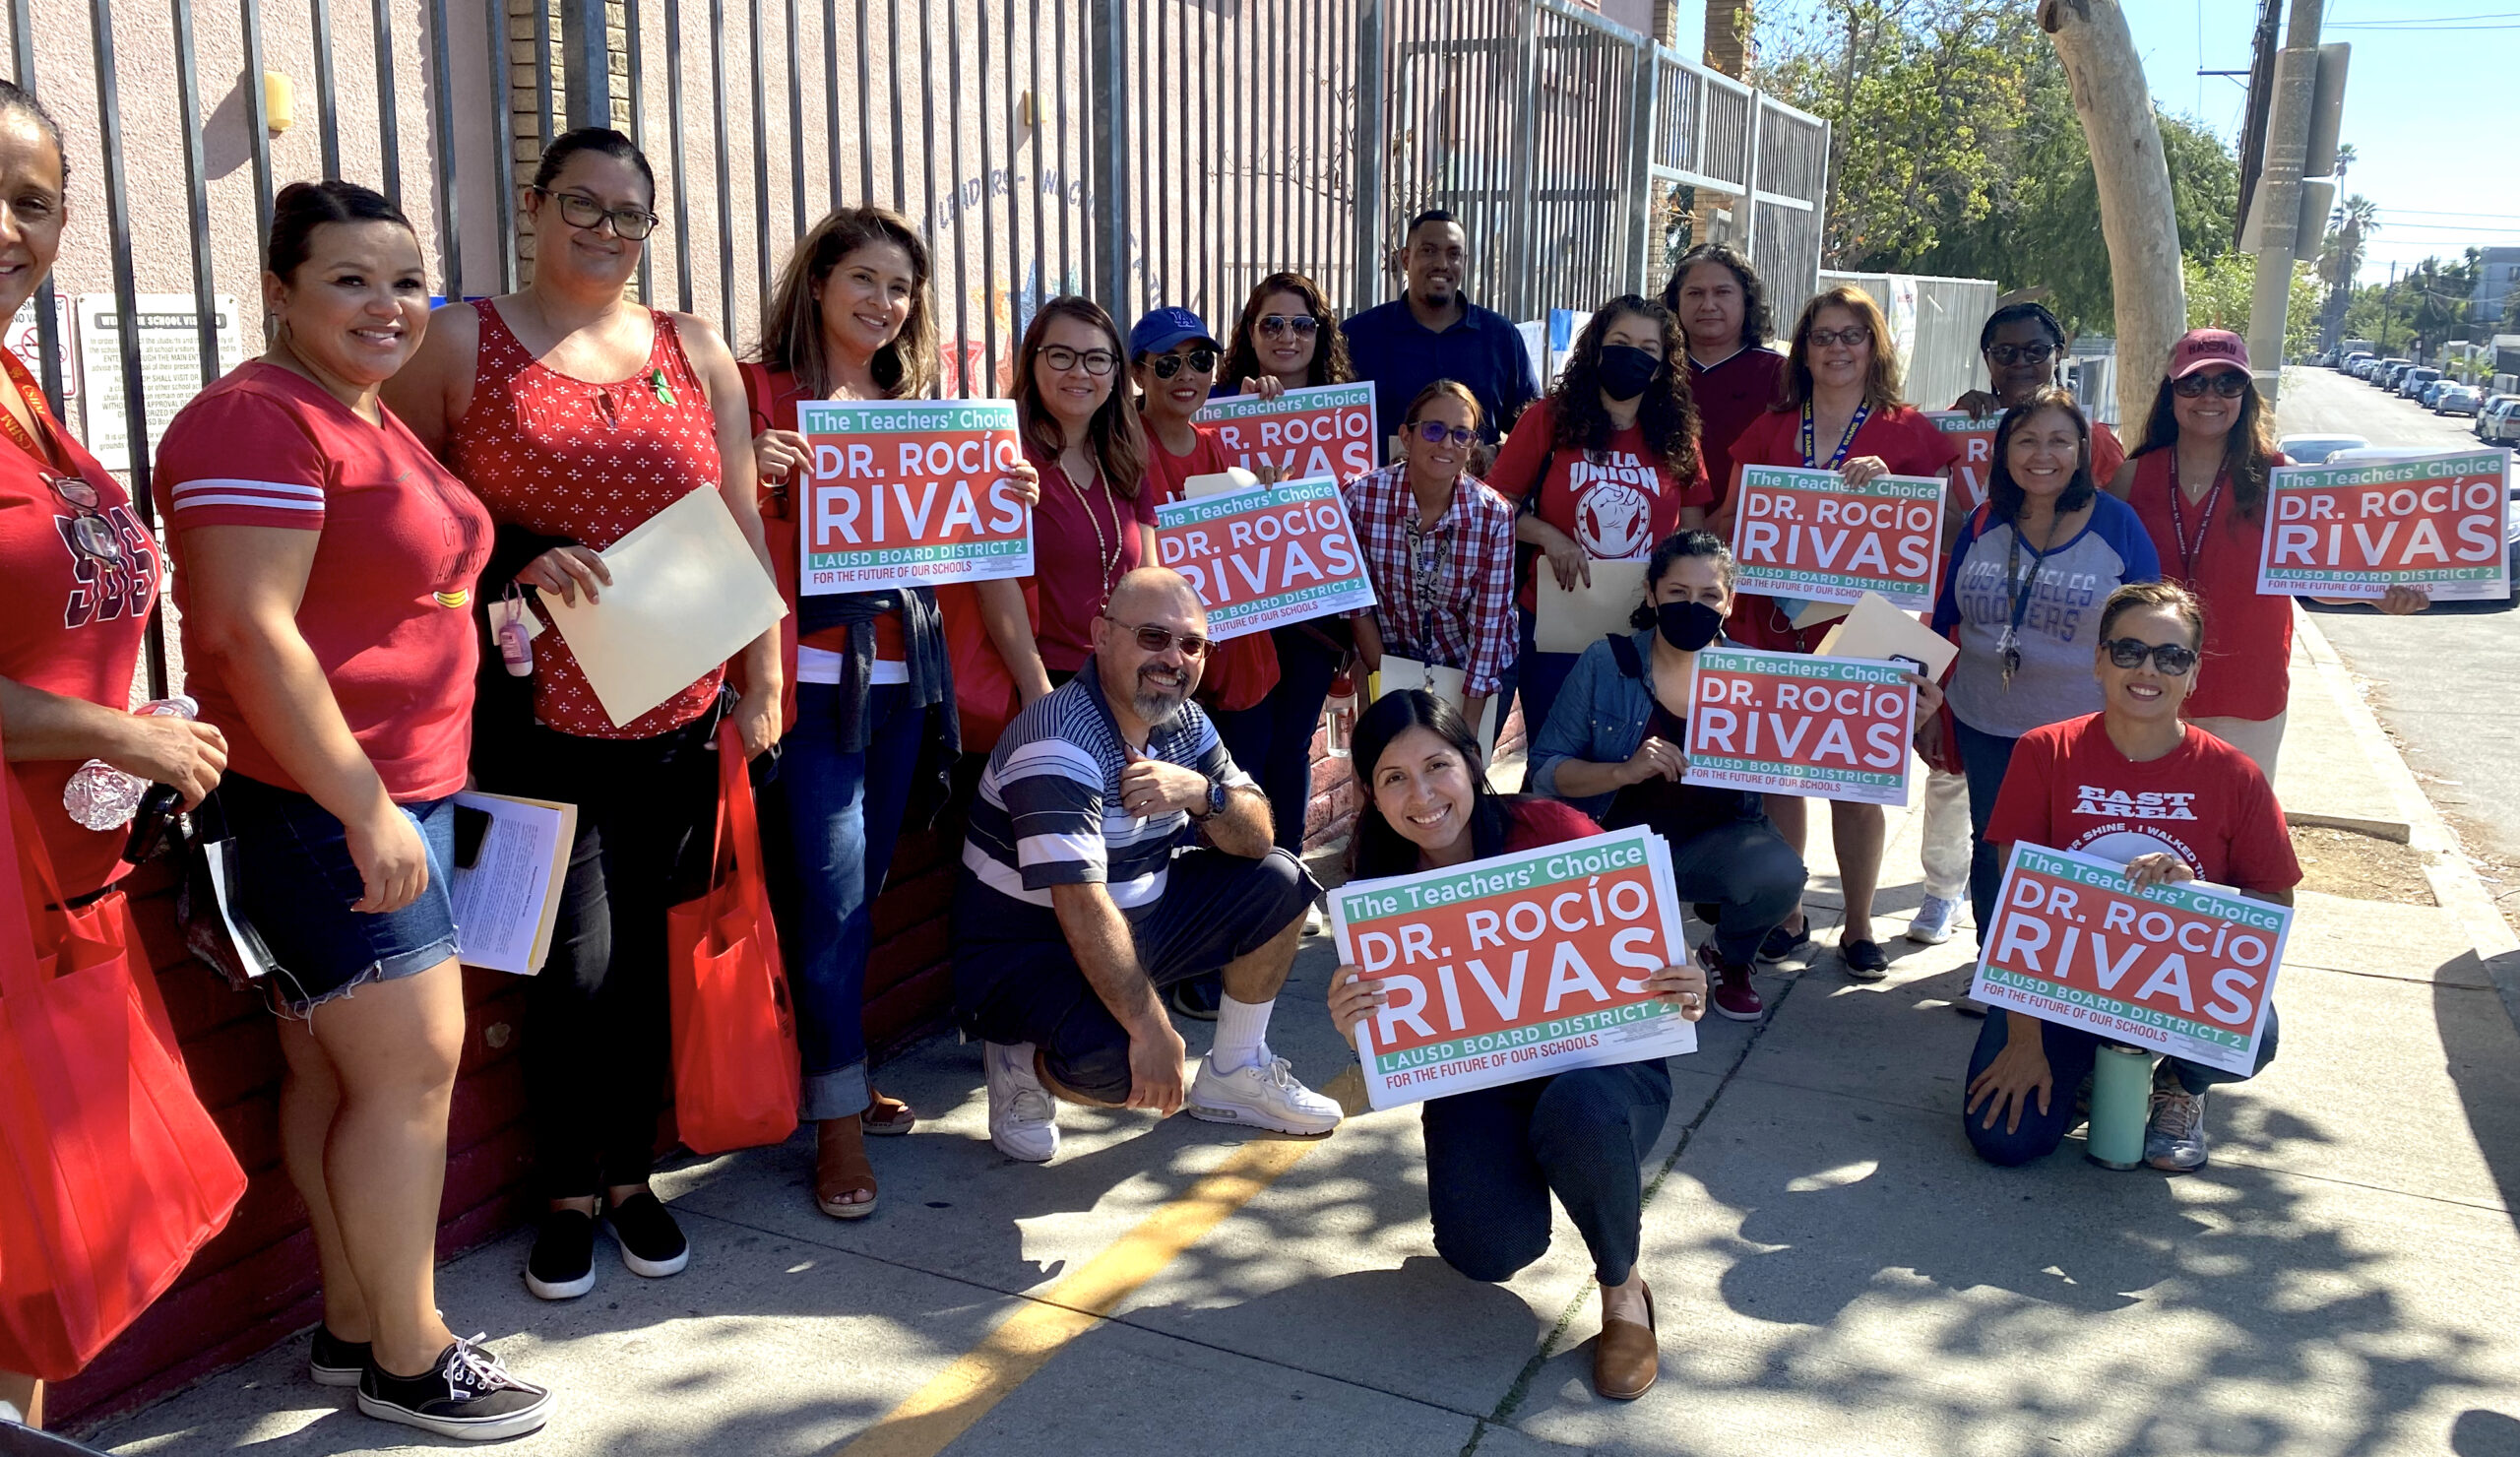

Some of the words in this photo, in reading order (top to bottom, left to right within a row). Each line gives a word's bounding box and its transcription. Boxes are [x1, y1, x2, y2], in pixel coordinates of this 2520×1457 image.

[148, 316, 182, 326] SCHOOL
[809, 412, 850, 432] The
[856, 411, 955, 432] Teachers'
[960, 410, 1015, 429] Choice
[1195, 408, 1223, 421] The
[1228, 396, 1306, 417] Teachers'
[1312, 392, 1368, 408] Choice
[1936, 417, 2000, 431] Teache
[1220, 426, 1250, 450] R.
[1261, 408, 1368, 447] ROCÍO
[814, 443, 886, 480] DR.
[898, 429, 1019, 477] ROCÍO
[1239, 441, 1370, 483] IVAS
[2278, 472, 2317, 489] The
[2324, 464, 2421, 486] Teachers'
[2426, 458, 2501, 477] Choice
[1570, 461, 1661, 497] UNION
[1749, 472, 1783, 487] The
[1786, 475, 1873, 495] Teachs'
[1876, 481, 1938, 500] Choice
[2278, 494, 2346, 521] DR.
[2360, 474, 2498, 519] ROCÍO
[815, 477, 1024, 546] RIVAS
[1157, 512, 1185, 528] The
[1189, 492, 1273, 521] Teachers'
[1278, 485, 1334, 505] Choice
[1747, 492, 1804, 521] DR.
[1815, 491, 1936, 533] ROCÍO
[813, 550, 873, 568] LAUSD
[878, 546, 935, 564] BOARD
[940, 541, 1009, 559] DISTRICT
[1014, 539, 1023, 553] 2
[1160, 530, 1222, 565] DR.
[1229, 501, 1341, 548] ROCÍO
[1741, 520, 1930, 578] RIVAS
[2273, 514, 2498, 567] RIVAS
[813, 571, 835, 585] FOR
[836, 569, 855, 584] THE
[857, 566, 896, 583] FUTURE
[896, 565, 911, 579] OF
[911, 564, 930, 577] OUR
[932, 560, 973, 575] SCHOOLS
[1172, 534, 1355, 606] RIVAS
[1735, 577, 1754, 587] FOR
[1753, 578, 1770, 589] THE
[1770, 580, 1802, 592] FUTURE
[1802, 584, 1815, 594] OF
[1814, 585, 1834, 596] OUR
[1834, 587, 1863, 599] SCHOO
[1789, 570, 1840, 584] BOARD
[1844, 576, 1912, 592] DISTRICT
[1915, 583, 1924, 594] 2
[2267, 579, 2287, 589] FOR
[2289, 580, 2308, 590] THE
[2308, 581, 2348, 592] FUTURE
[2349, 582, 2363, 593] OF
[2363, 583, 2386, 594] OUR
[2269, 569, 2326, 580] LAUSD
[2331, 570, 2394, 583] BOARD
[2398, 568, 2479, 582] DISTRICT
[2485, 567, 2495, 579] 2
[1215, 614, 1248, 633] FUTURE
[1248, 613, 1260, 625] OF
[1261, 609, 1280, 622] OUR
[1280, 602, 1319, 618] SCHOOLS
[1230, 597, 1280, 617] BOARD
[1286, 582, 1348, 604] DISTRICT
[1354, 579, 1361, 590] 2
[1961, 593, 2082, 642] DODERS
[1702, 653, 1738, 670] The
[1742, 657, 1835, 680] Teachers'
[1840, 665, 1910, 686] Choice
[1701, 676, 1763, 708] DR.
[1776, 675, 1907, 720] ROCÍO
[1696, 706, 1902, 769] RIVAS
[1691, 768, 1710, 779] FOR
[1710, 770, 1729, 781] THE
[1729, 772, 1764, 785] FUTURE
[1765, 776, 1778, 787] OF
[1778, 777, 1798, 789] OUR
[1799, 780, 1842, 793] SCHOOLS
[1693, 755, 1744, 770] LAUSD
[1749, 760, 1804, 778] BOARD
[1809, 767, 1883, 785] DISTRICT
[1887, 775, 1898, 786] 2
[2072, 799, 2198, 820] AREA
[2077, 785, 2195, 807] EAST
[2148, 826, 2197, 862] WALKED
[2195, 862, 2207, 881] TH
[1346, 895, 1400, 922] The
[1404, 862, 1536, 911] Teachers'
[1545, 847, 1643, 882] Choice
[2020, 851, 2064, 877] The
[2191, 895, 2279, 931] Choice
[1357, 922, 1453, 974] DR.
[1462, 864, 1650, 952] ROCÍO
[2011, 876, 2087, 923] DR.
[2103, 891, 2274, 968] ROCÍO
[1368, 926, 1670, 1046] RIVAS
[1995, 910, 2261, 1026] RIVAS
[1983, 981, 2006, 997] FOR
[2006, 987, 2029, 1004] THE
[2028, 993, 2073, 1017] FUTURE
[2071, 1006, 2089, 1021] OF
[2088, 1011, 2114, 1029] OUR
[2113, 1018, 2170, 1045] SCHOOLS
[1988, 967, 2051, 993] LAUSD
[2055, 985, 2124, 1014] BOARD
[2130, 1005, 2225, 1042] DISTRICT
[2230, 1034, 2244, 1048] 2
[1381, 1042, 1455, 1071] LAUSD
[1462, 1023, 1541, 1054] BOARD
[1547, 1001, 1650, 1037] DISTRICT
[1658, 1001, 1671, 1013] 2
[1386, 1071, 1413, 1091] FOR
[1414, 1067, 1439, 1084] THE
[1439, 1054, 1491, 1080] FUTURE
[1490, 1050, 1510, 1069] OF
[1509, 1045, 1540, 1065] OUR
[1540, 1033, 1600, 1059] SCHOOLS
